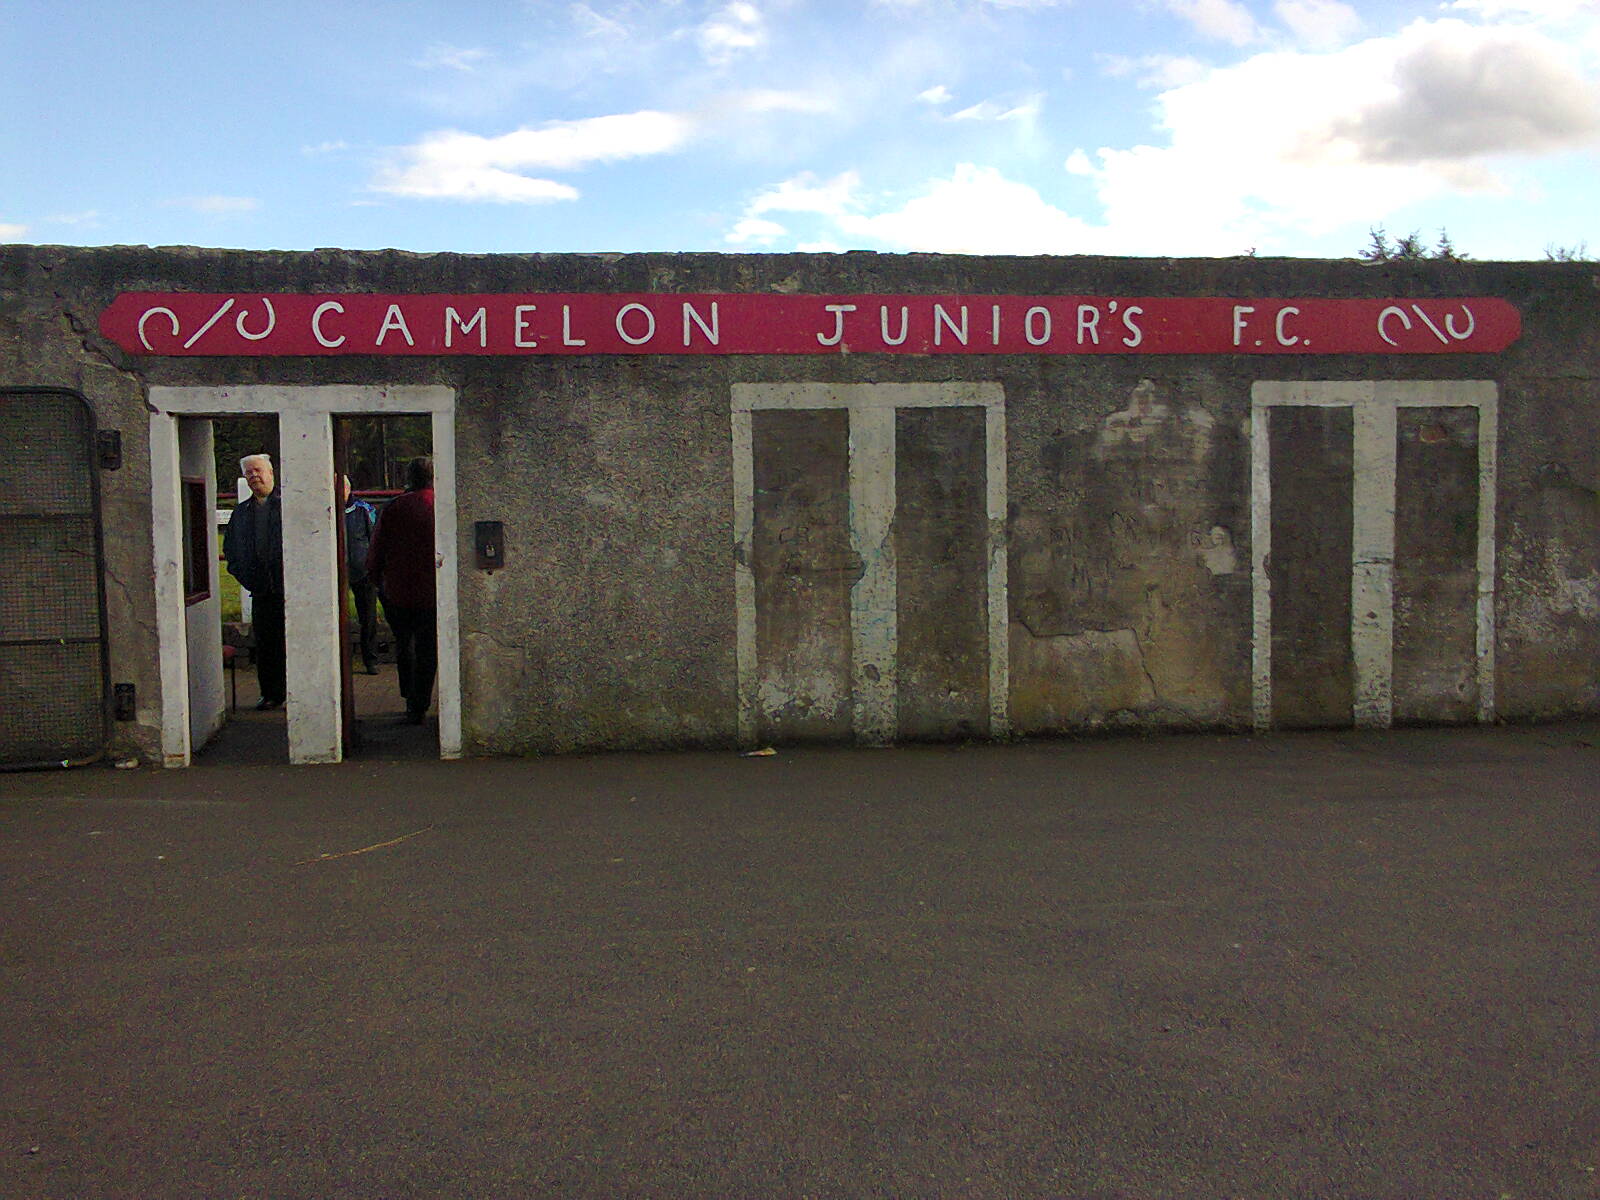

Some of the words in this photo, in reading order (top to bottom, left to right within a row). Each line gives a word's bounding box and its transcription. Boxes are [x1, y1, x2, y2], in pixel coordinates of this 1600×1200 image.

[312, 301, 719, 348] CAMELON
[816, 301, 1144, 347] JUNIOR'S
[1233, 305, 1312, 347] F.C.
